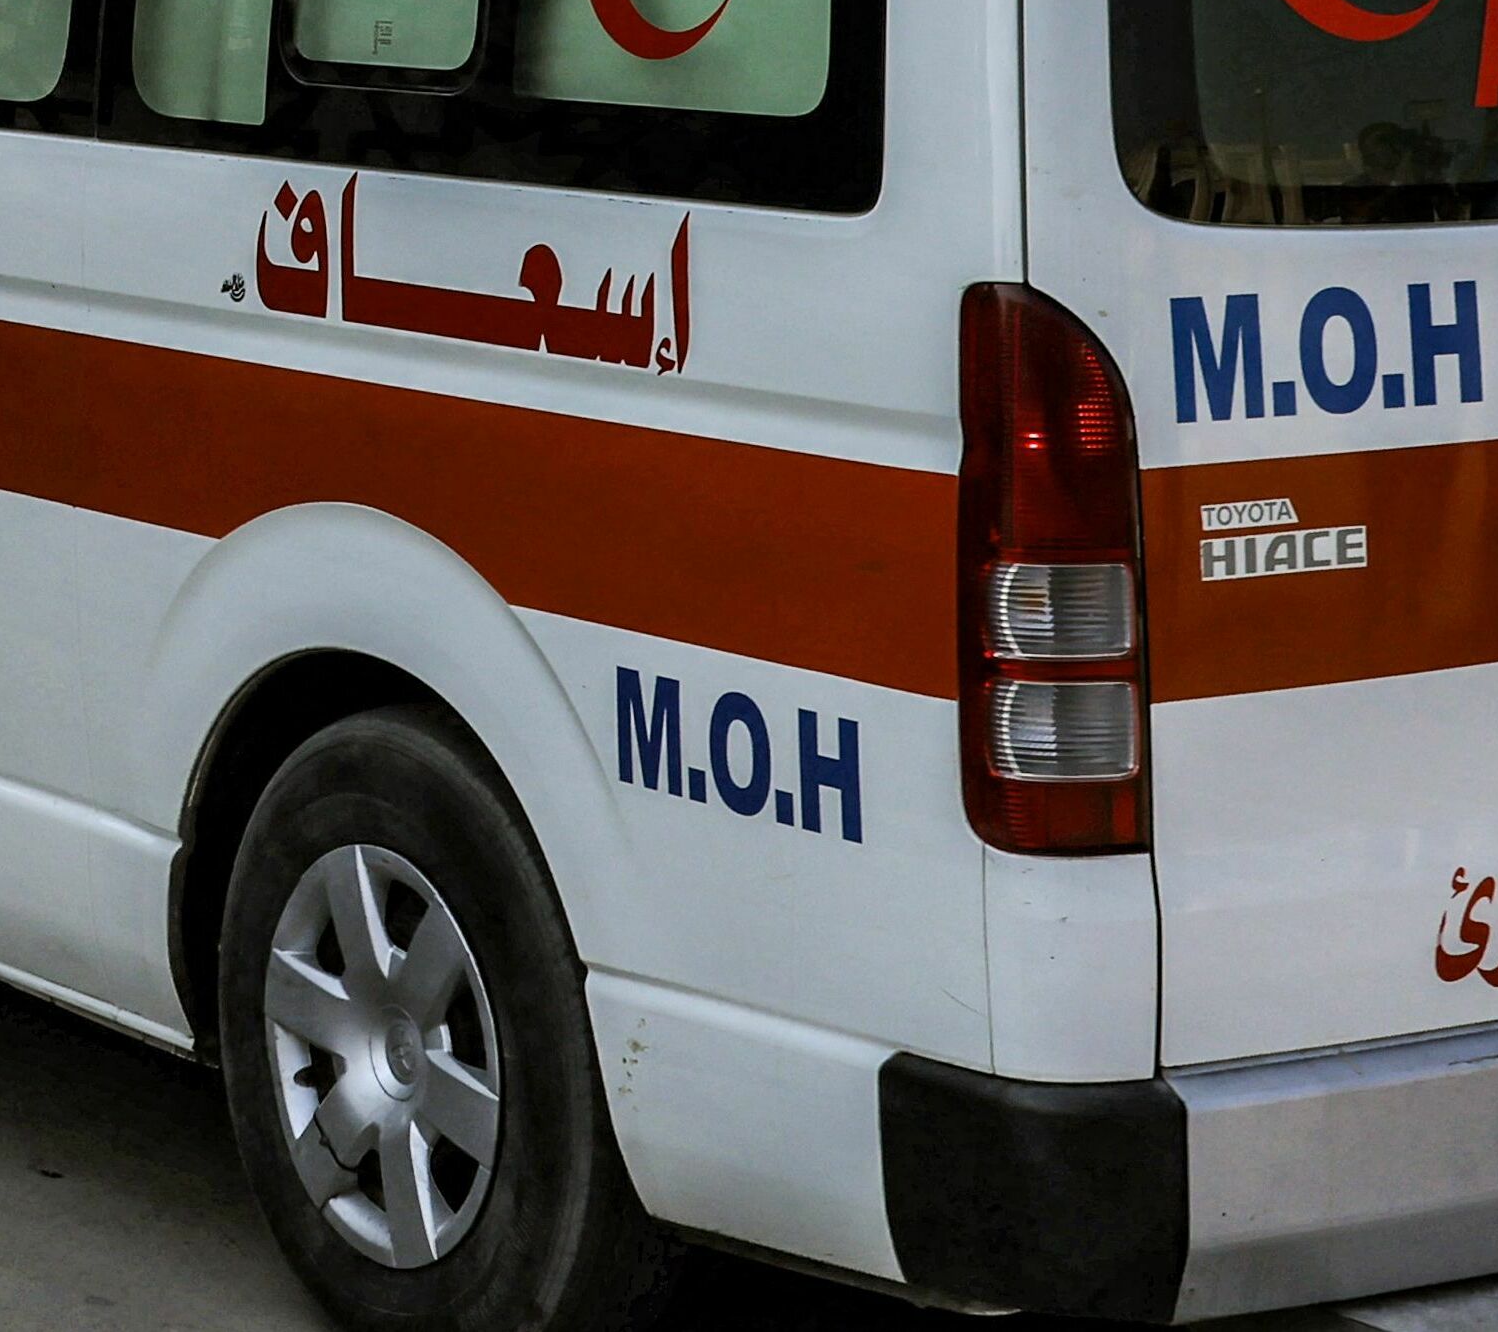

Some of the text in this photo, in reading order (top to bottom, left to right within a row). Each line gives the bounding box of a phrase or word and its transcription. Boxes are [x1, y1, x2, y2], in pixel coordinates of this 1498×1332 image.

[256, 171, 691, 376] إسعاف
[1170, 280, 1483, 424] M.O.H
[1202, 501, 1292, 527] TOYOTA
[1202, 528, 1366, 578] HIACE
[616, 666, 863, 845] M.O.H
